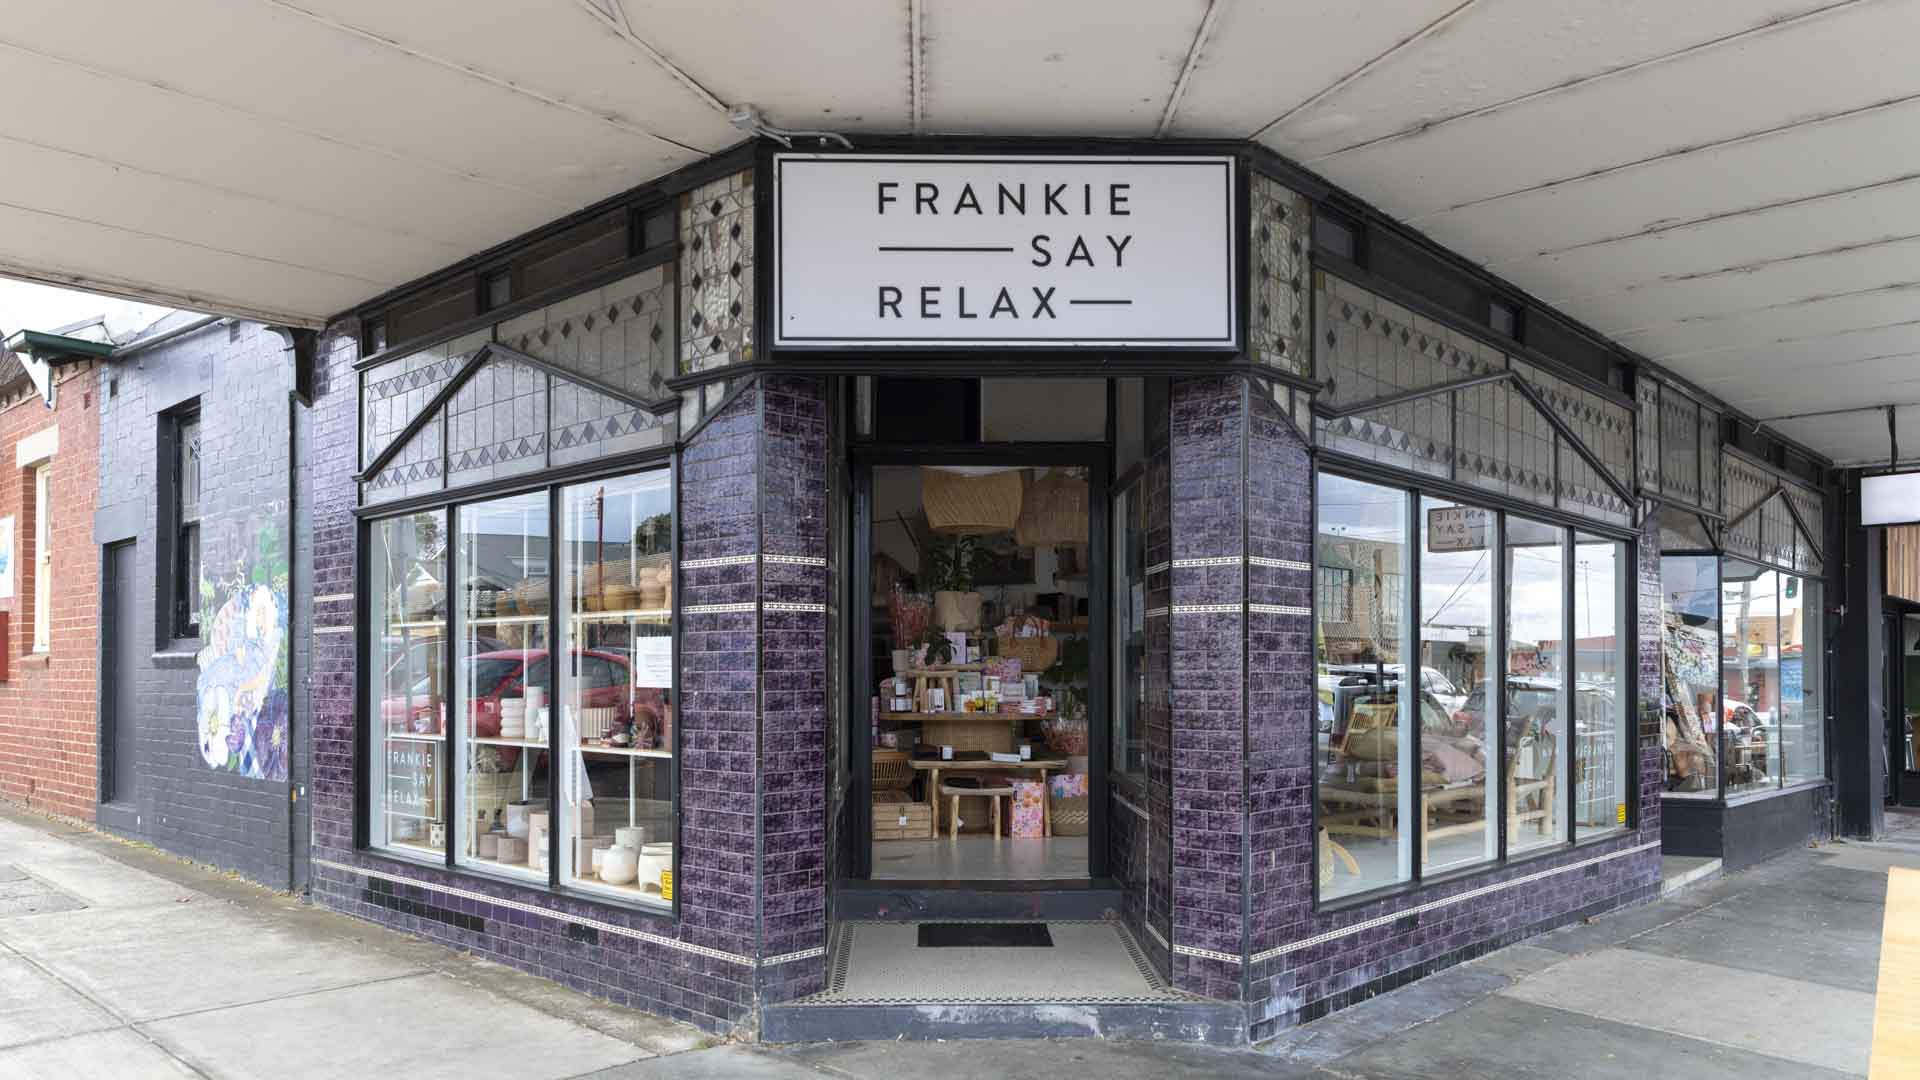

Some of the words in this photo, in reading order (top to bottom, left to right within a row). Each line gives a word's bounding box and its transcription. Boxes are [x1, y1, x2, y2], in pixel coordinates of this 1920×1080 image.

[878, 182, 1131, 216] FRANKIE
[1031, 234, 1132, 268] SAY
[878, 286, 1057, 319] RELAX
